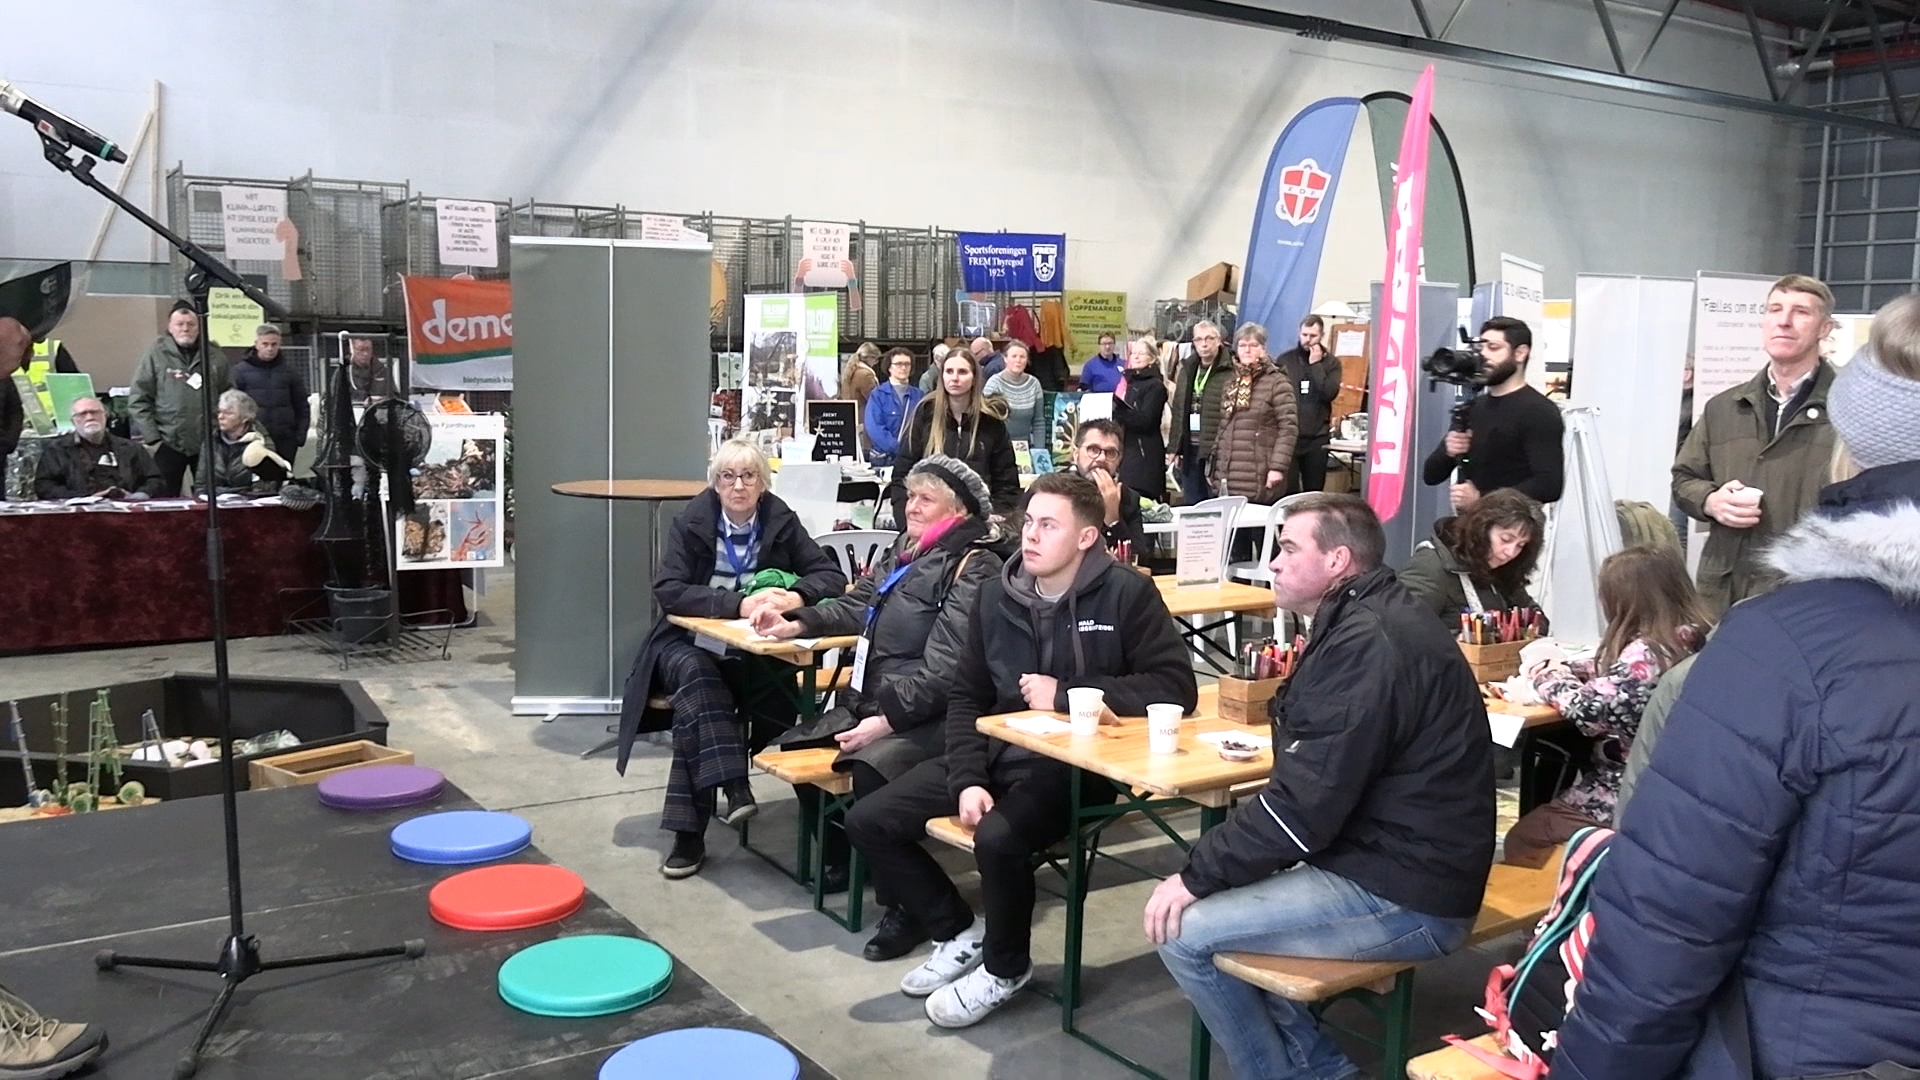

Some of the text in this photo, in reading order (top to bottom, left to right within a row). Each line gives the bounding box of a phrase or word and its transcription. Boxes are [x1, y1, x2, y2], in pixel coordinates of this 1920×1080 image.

[964, 244, 1027, 257] Sportsforeningen
[968, 257, 1024, 268] FREM Thyregod
[989, 268, 1005, 277] 1925
[422, 298, 513, 345] deme
